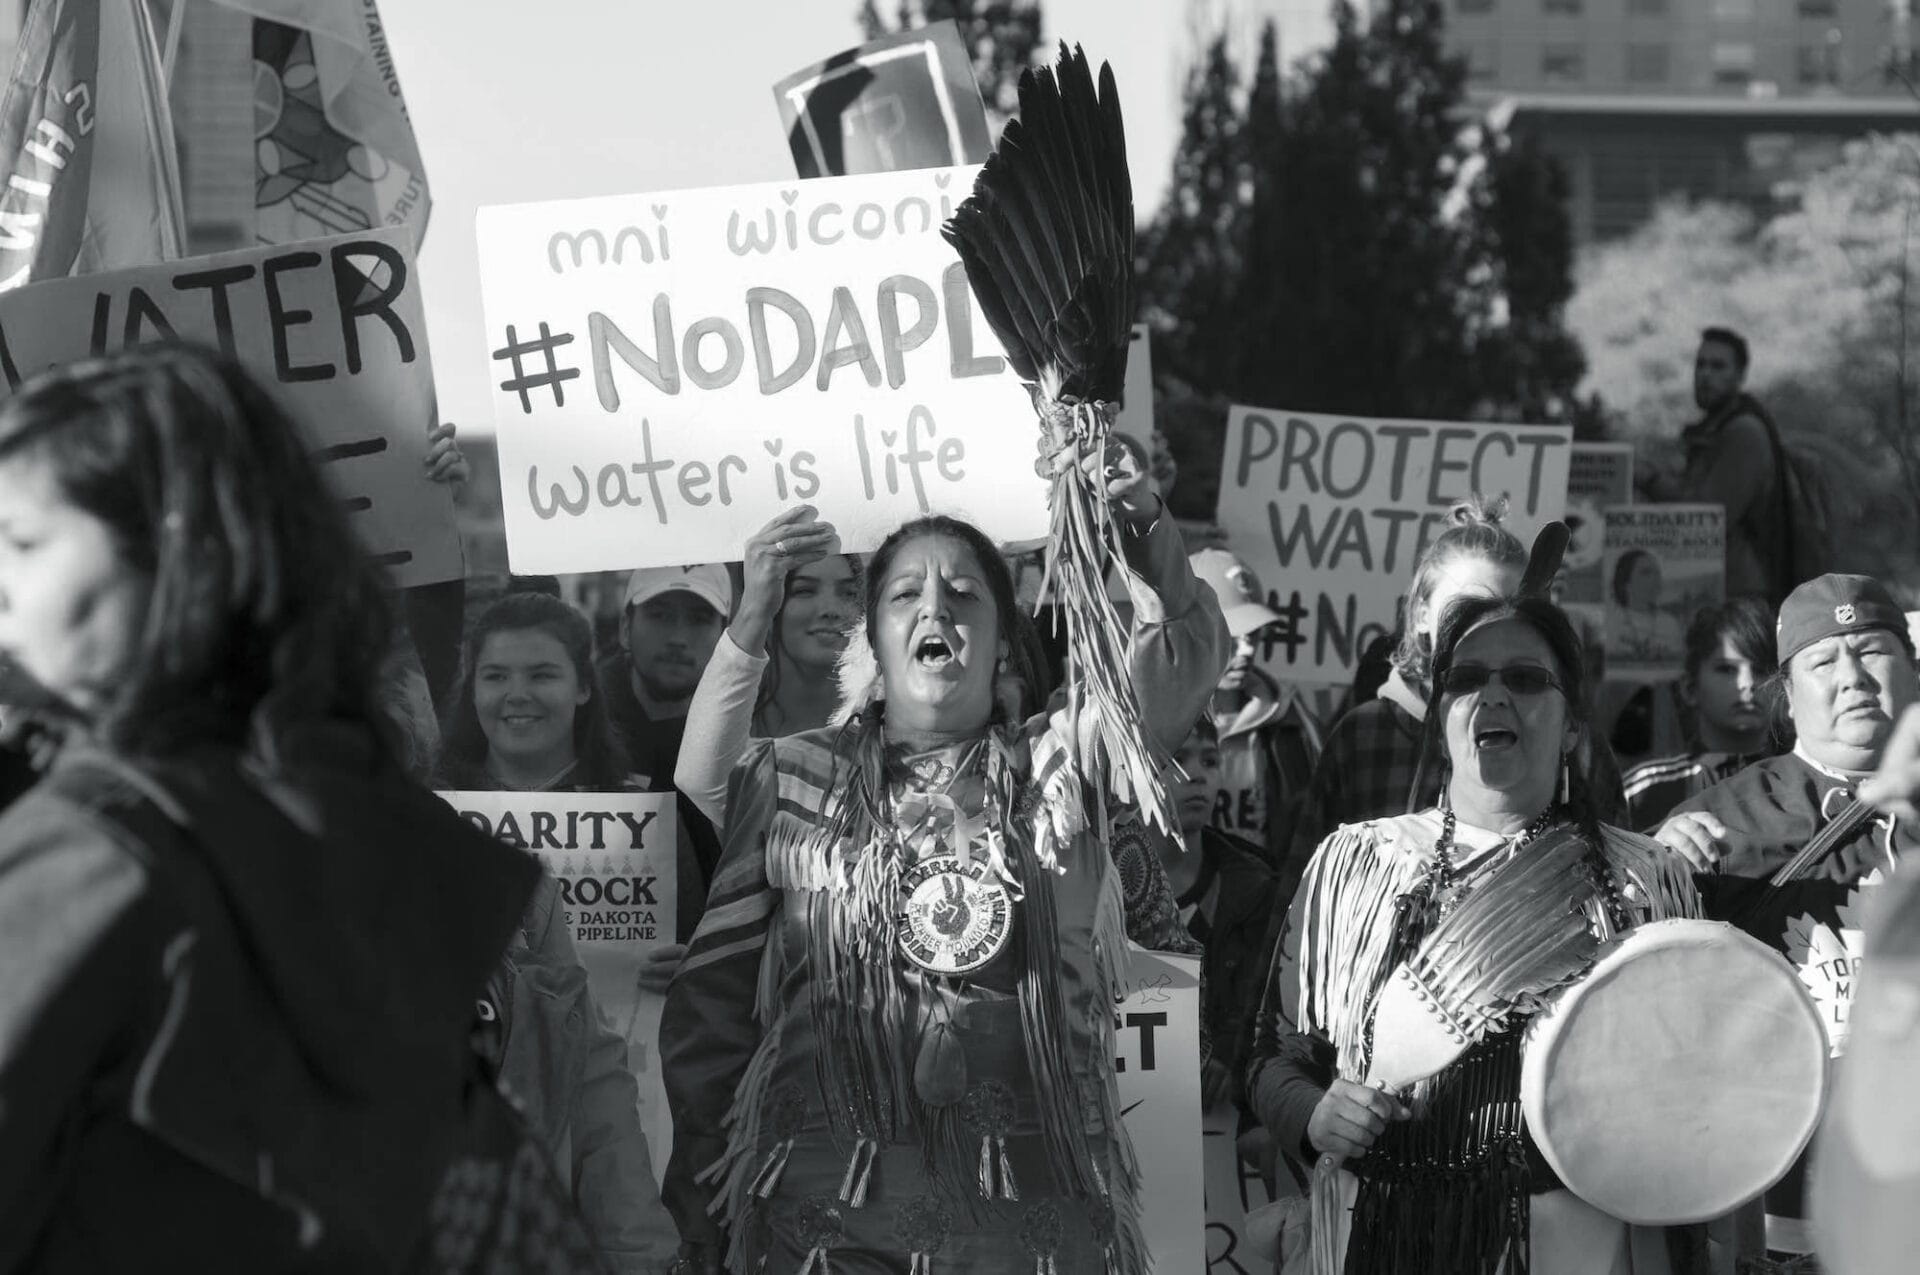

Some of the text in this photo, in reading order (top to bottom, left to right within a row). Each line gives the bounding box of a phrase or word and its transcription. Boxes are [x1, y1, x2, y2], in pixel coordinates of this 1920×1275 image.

[548, 173, 951, 274] mni wiconi
[493, 261, 1005, 413] #NoDAPL
[528, 418, 747, 524] water
[764, 438, 820, 500] is
[855, 404, 965, 514] life
[1237, 414, 1567, 517] PROTECT
[577, 927, 657, 940] PIPELINE
[580, 911, 657, 924] DAKOTA
